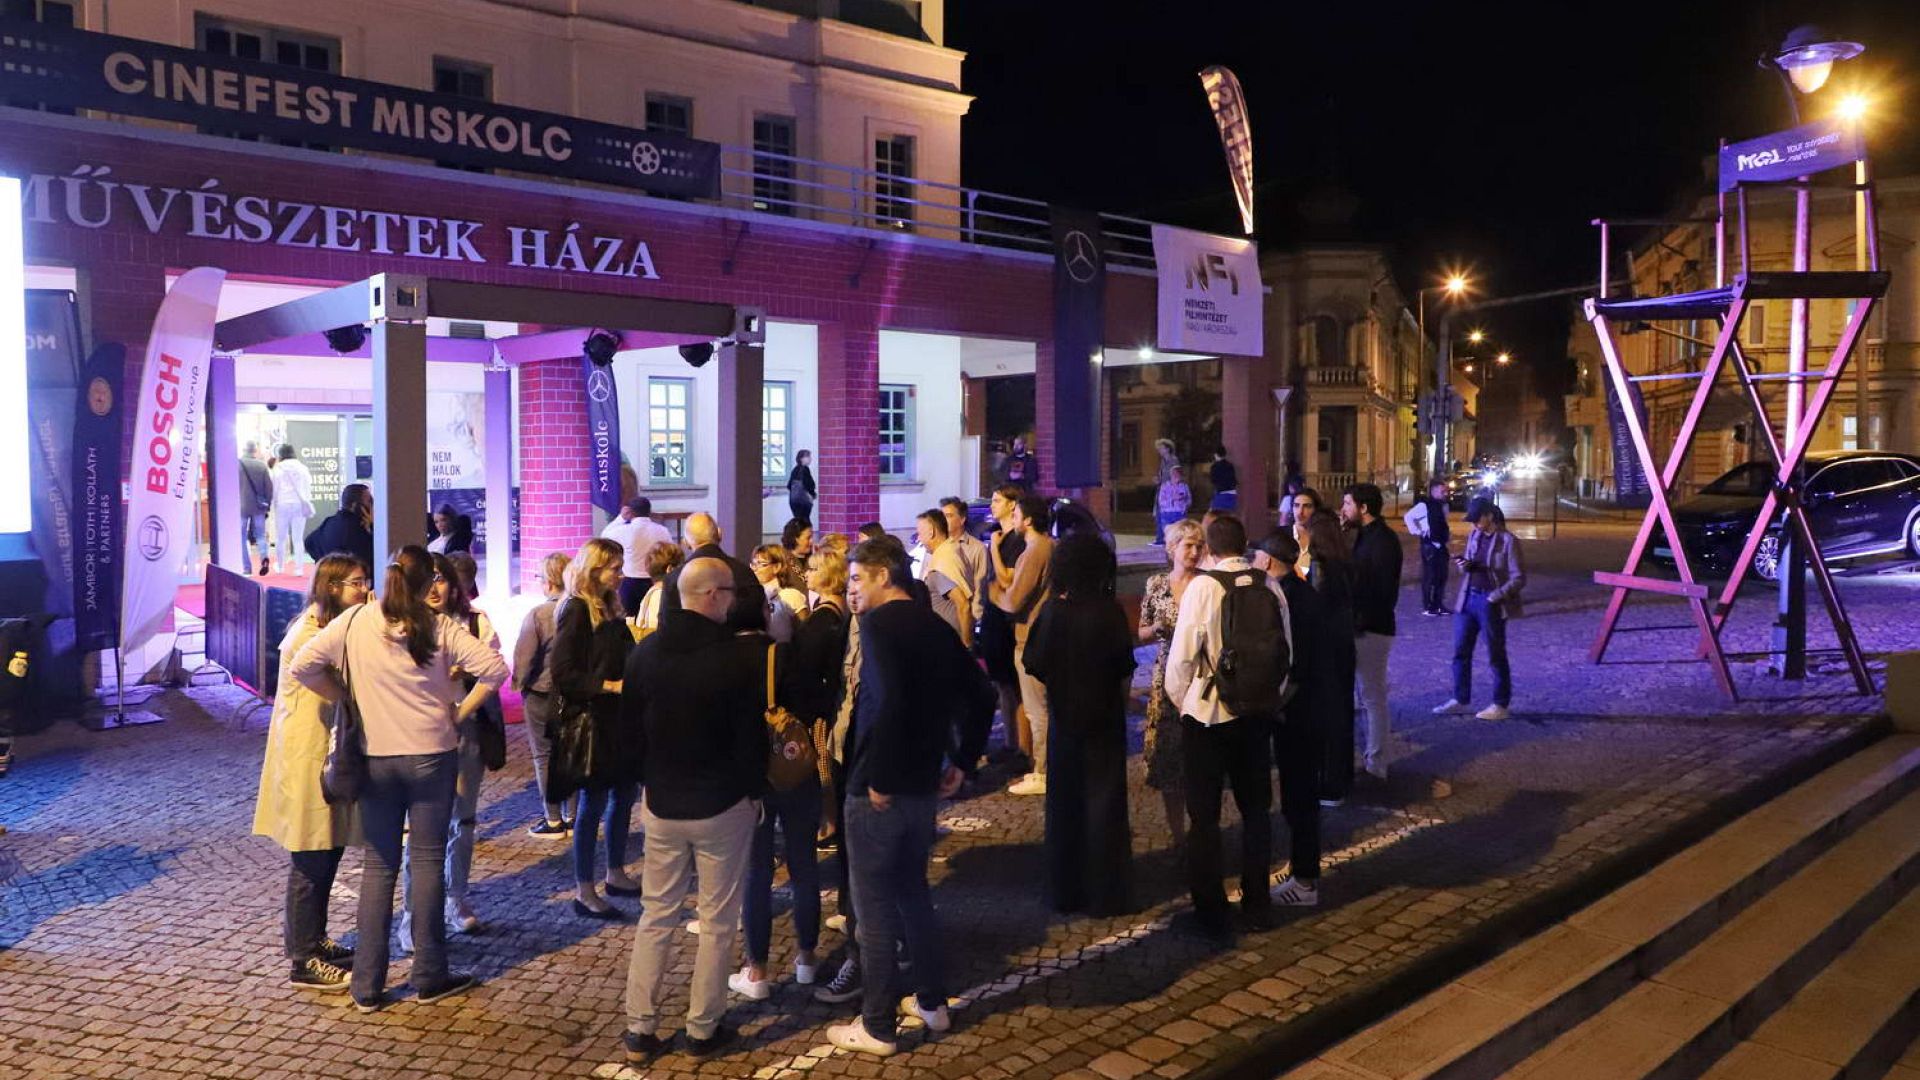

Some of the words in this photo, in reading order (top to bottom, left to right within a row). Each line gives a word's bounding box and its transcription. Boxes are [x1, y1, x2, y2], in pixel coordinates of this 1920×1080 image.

[103, 52, 357, 128] CINEFEST
[372, 97, 572, 161] MISKOLC
[23, 164, 486, 263] MŰVÉSZETEK
[507, 222, 660, 279] HÁZA
[147, 353, 182, 494] BOSCH
[301, 447, 346, 458] CINEF
[432, 452, 451, 463] NEM
[432, 478, 451, 489] MEG
[101, 494, 111, 551] PARTNERS
